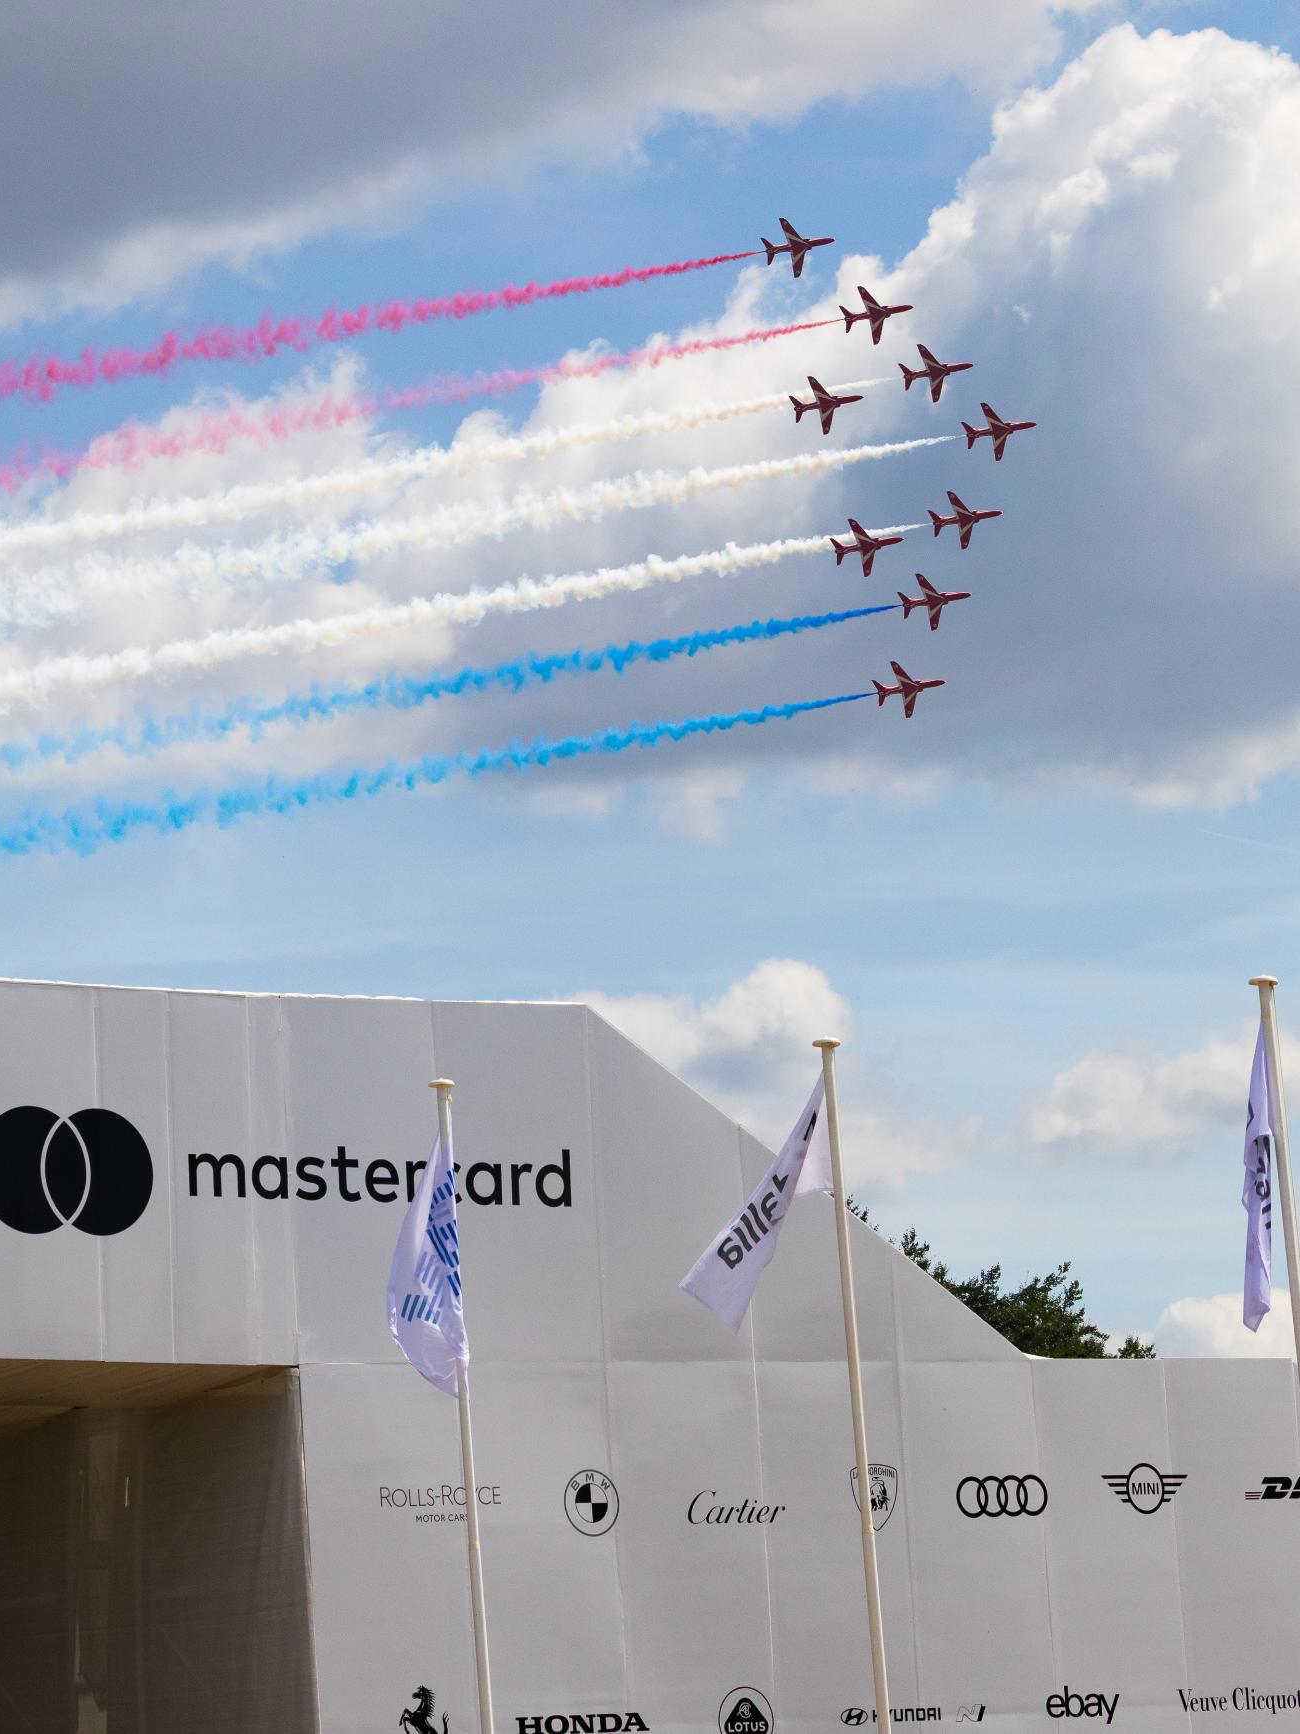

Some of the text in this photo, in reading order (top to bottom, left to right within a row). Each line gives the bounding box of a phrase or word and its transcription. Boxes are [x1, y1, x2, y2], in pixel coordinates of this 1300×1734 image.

[188, 1146, 572, 1208] masterard
[570, 1472, 611, 1491] BMW
[853, 1466, 896, 1480] LORGHINI
[379, 1485, 502, 1508] ROLLS-ROCE
[1131, 1482, 1160, 1495] MINI
[1260, 1476, 1300, 1500] D
[687, 1489, 786, 1525] Cartier
[415, 1514, 446, 1523] MOTOR
[1046, 1685, 1120, 1725] ebay
[1176, 1688, 1228, 1713] Veuve
[515, 1712, 650, 1734] HONDA
[872, 1707, 942, 1723] HUNDAI
[727, 1721, 766, 1733] LOTUS
